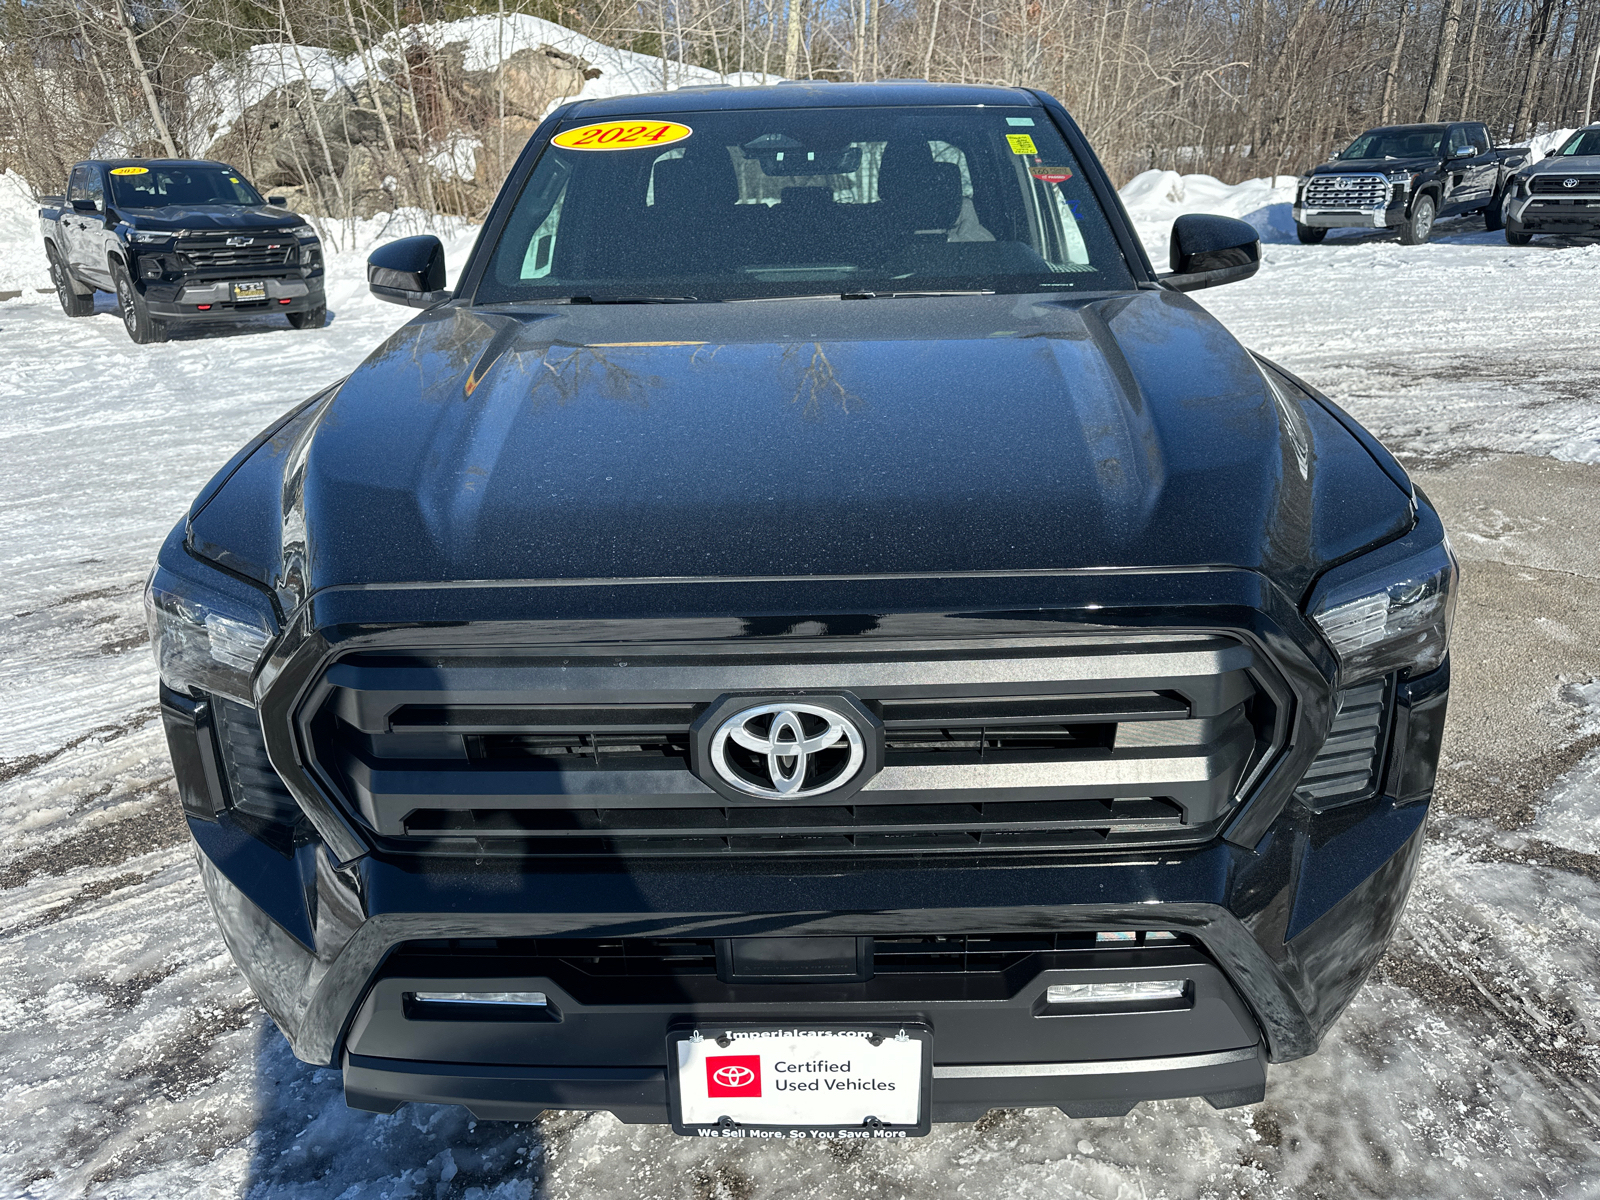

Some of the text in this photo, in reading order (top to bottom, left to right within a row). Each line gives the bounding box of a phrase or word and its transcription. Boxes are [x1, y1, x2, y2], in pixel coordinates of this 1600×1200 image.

[572, 125, 671, 145] 2024
[725, 1029, 873, 1040] Imperialcars.com
[774, 1060, 851, 1073] Certified
[775, 1078, 896, 1092] Used Vehicles
[698, 1128, 907, 1140] We Sell More, So You Save More
